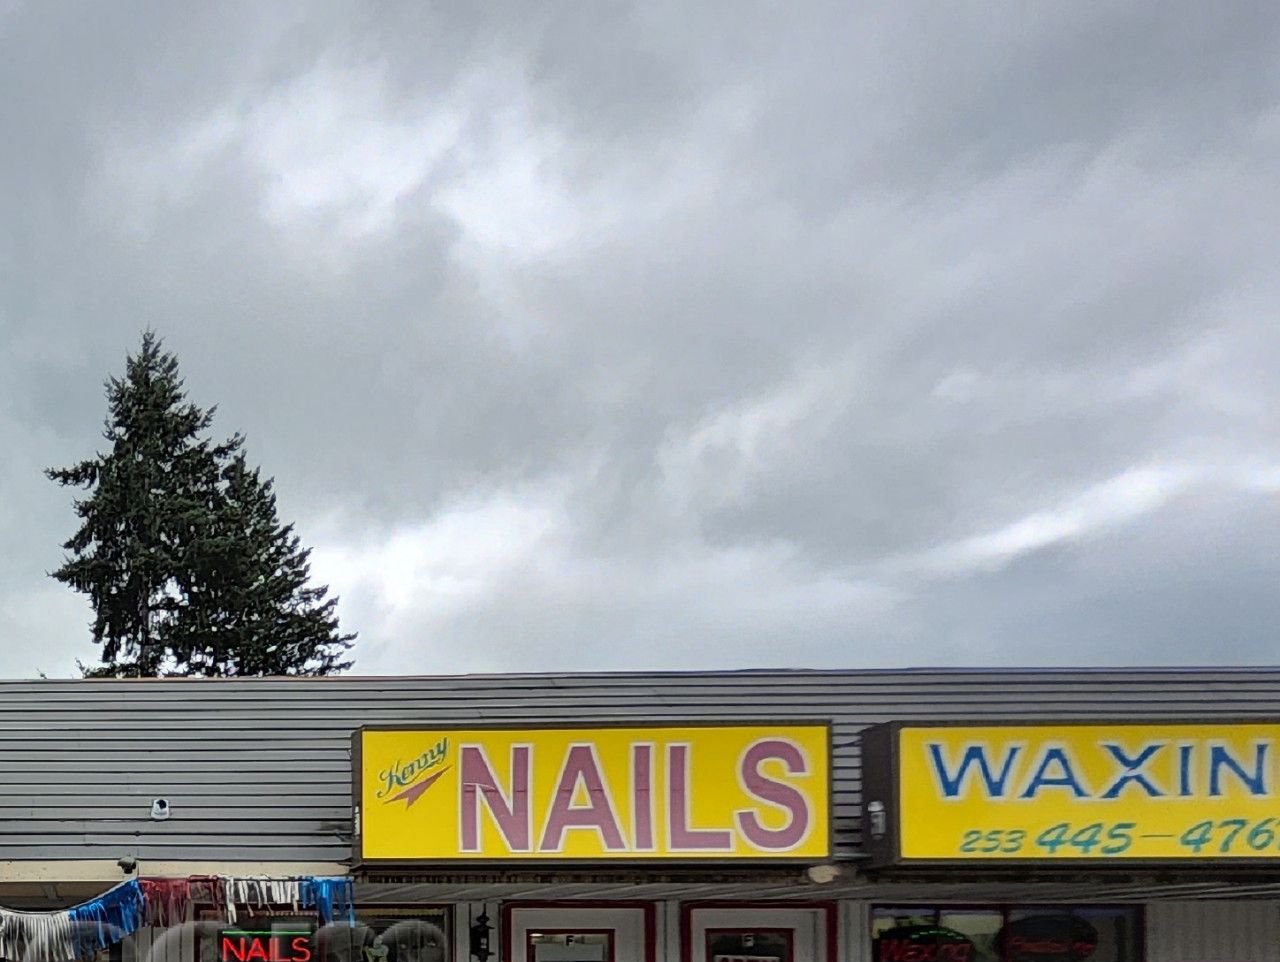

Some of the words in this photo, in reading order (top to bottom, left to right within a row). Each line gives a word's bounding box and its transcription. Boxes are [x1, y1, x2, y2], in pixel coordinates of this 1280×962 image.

[376, 736, 449, 798] Kenny
[457, 737, 815, 853] NAILS
[926, 741, 1271, 801] WAXIN
[959, 829, 1028, 853] 253
[1035, 817, 1280, 855] 445-476
[222, 936, 312, 962] NAILS
